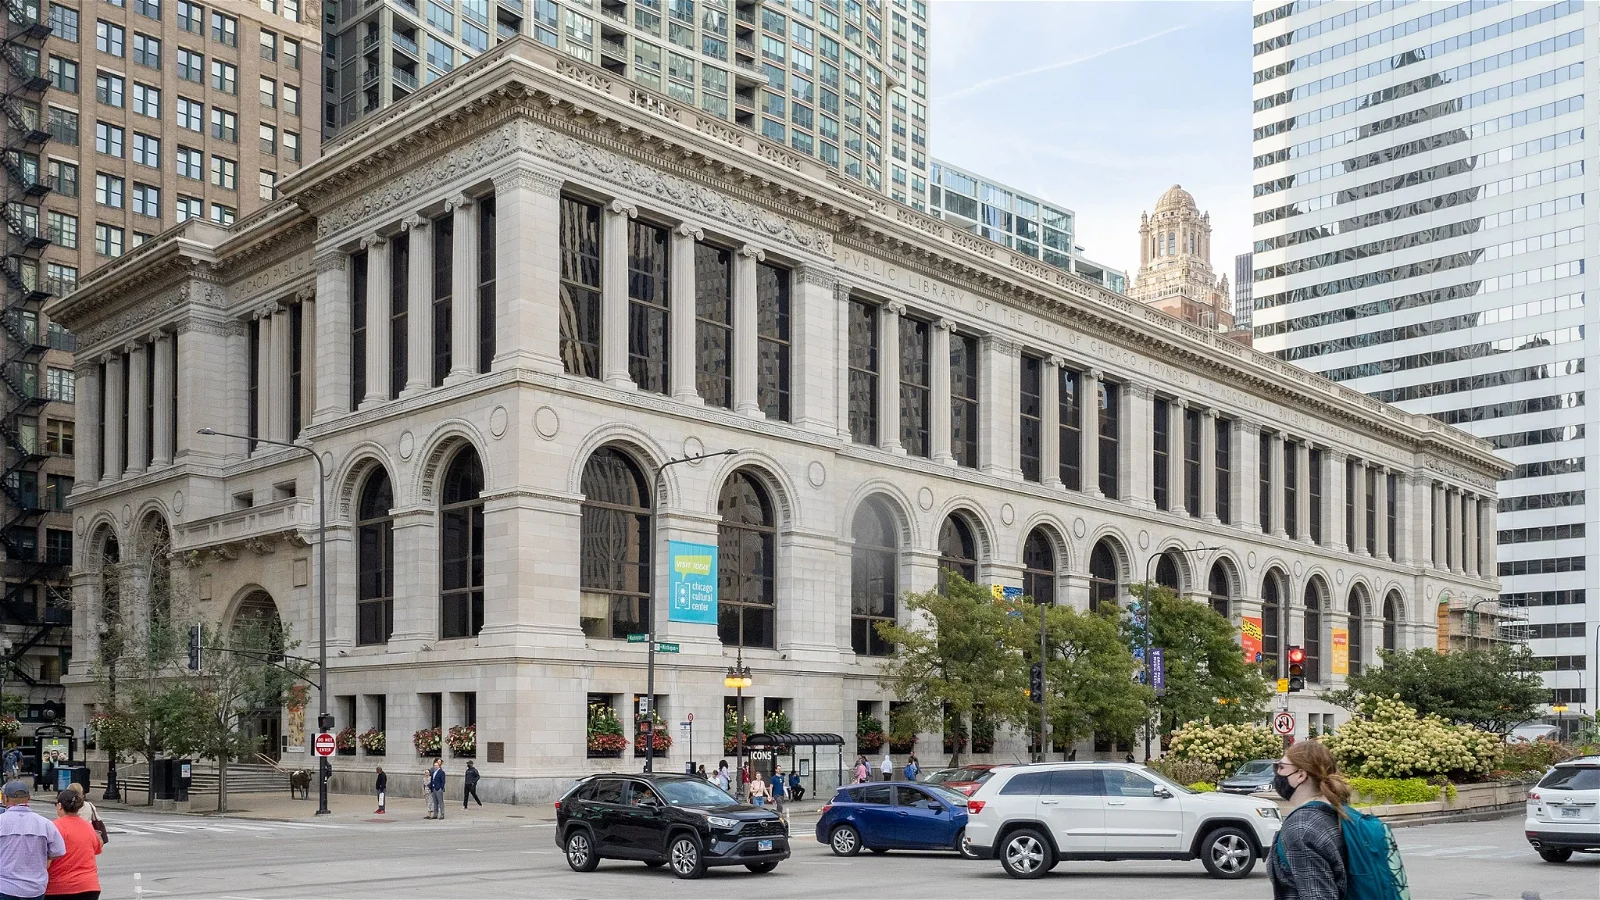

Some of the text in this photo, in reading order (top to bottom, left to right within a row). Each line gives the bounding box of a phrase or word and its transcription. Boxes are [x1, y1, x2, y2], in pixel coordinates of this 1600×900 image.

[234, 273, 269, 299] CHICAGO
[908, 274, 965, 306] LIBRARY
[976, 300, 991, 314] OF
[1002, 308, 1024, 327] THE
[1033, 320, 1060, 338] CITY
[1069, 333, 1081, 349] OF
[1090, 341, 1137, 366] CHICAGO
[676, 560, 709, 571] VISIT TODAY
[692, 581, 713, 593] chicago
[692, 592, 713, 602] cultural
[692, 603, 708, 611] center
[750, 751, 772, 760] ICONS
